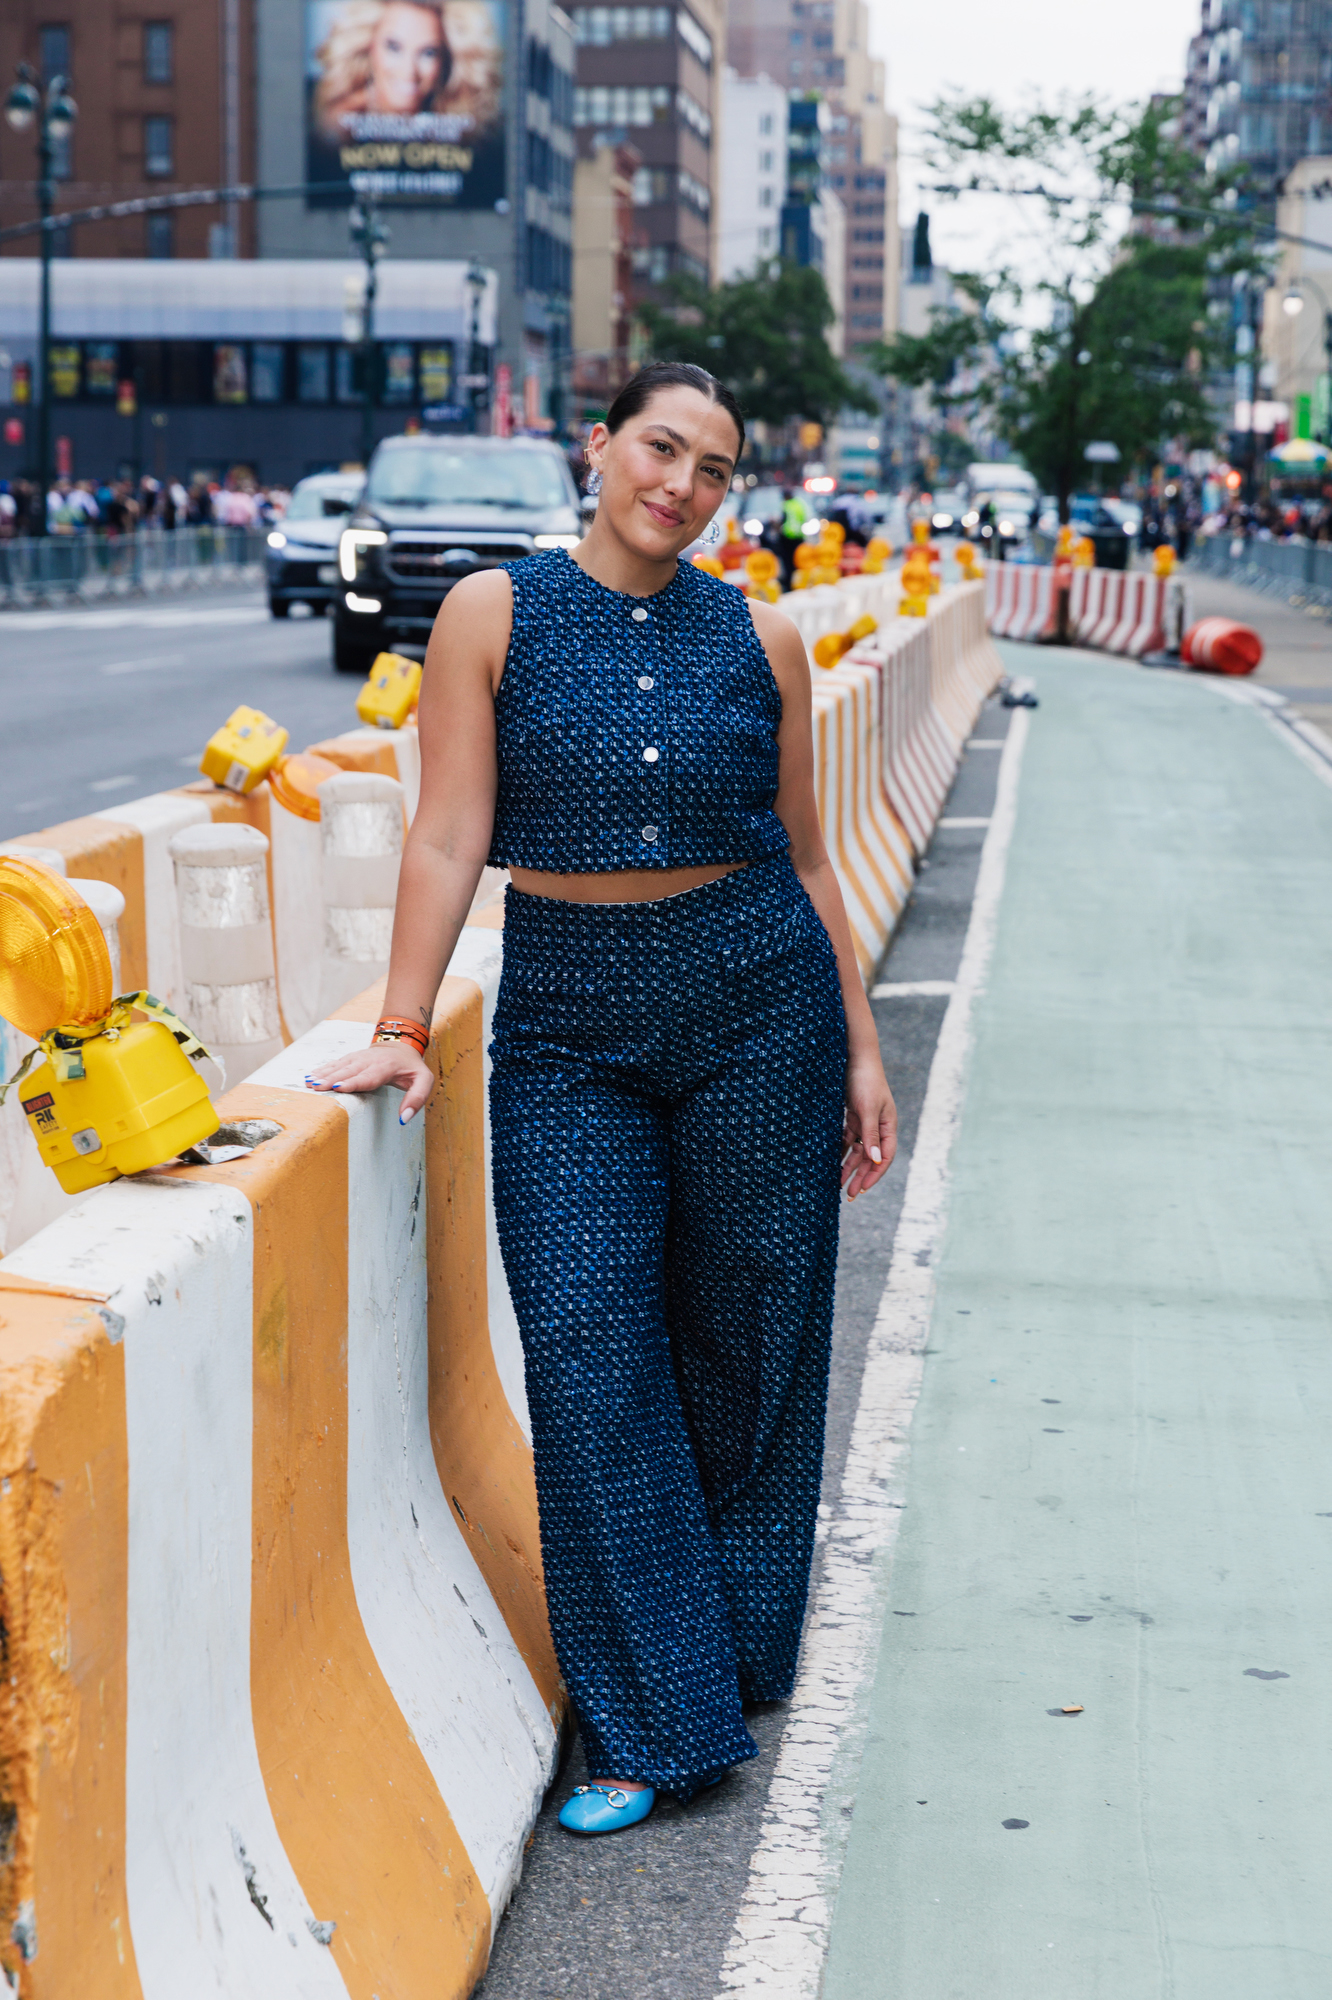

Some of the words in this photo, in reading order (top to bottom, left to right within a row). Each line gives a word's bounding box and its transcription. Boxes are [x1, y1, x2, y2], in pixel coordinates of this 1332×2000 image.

[340, 145, 401, 171] NOW
[402, 142, 474, 173] OPEN
[35, 1108, 55, 1126] RK
